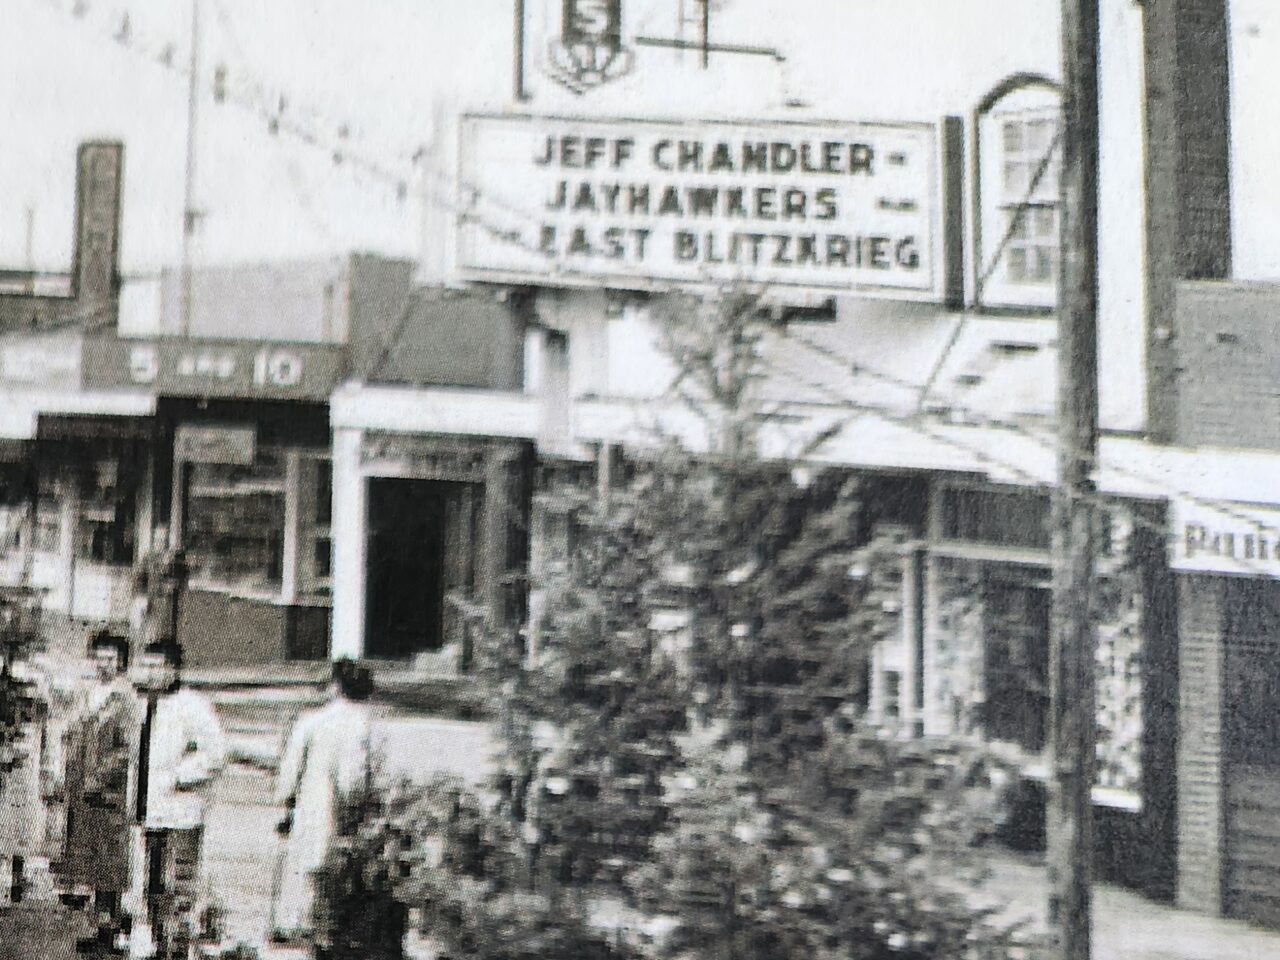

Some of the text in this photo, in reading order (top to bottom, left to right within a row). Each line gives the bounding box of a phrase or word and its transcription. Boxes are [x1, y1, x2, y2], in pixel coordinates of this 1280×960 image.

[534, 134, 636, 170] JEFF
[651, 138, 875, 177] CHANDLER
[545, 179, 839, 222] JAYHAWKERS
[673, 227, 921, 271] BLITZKRIEG
[253, 350, 303, 385] 10
